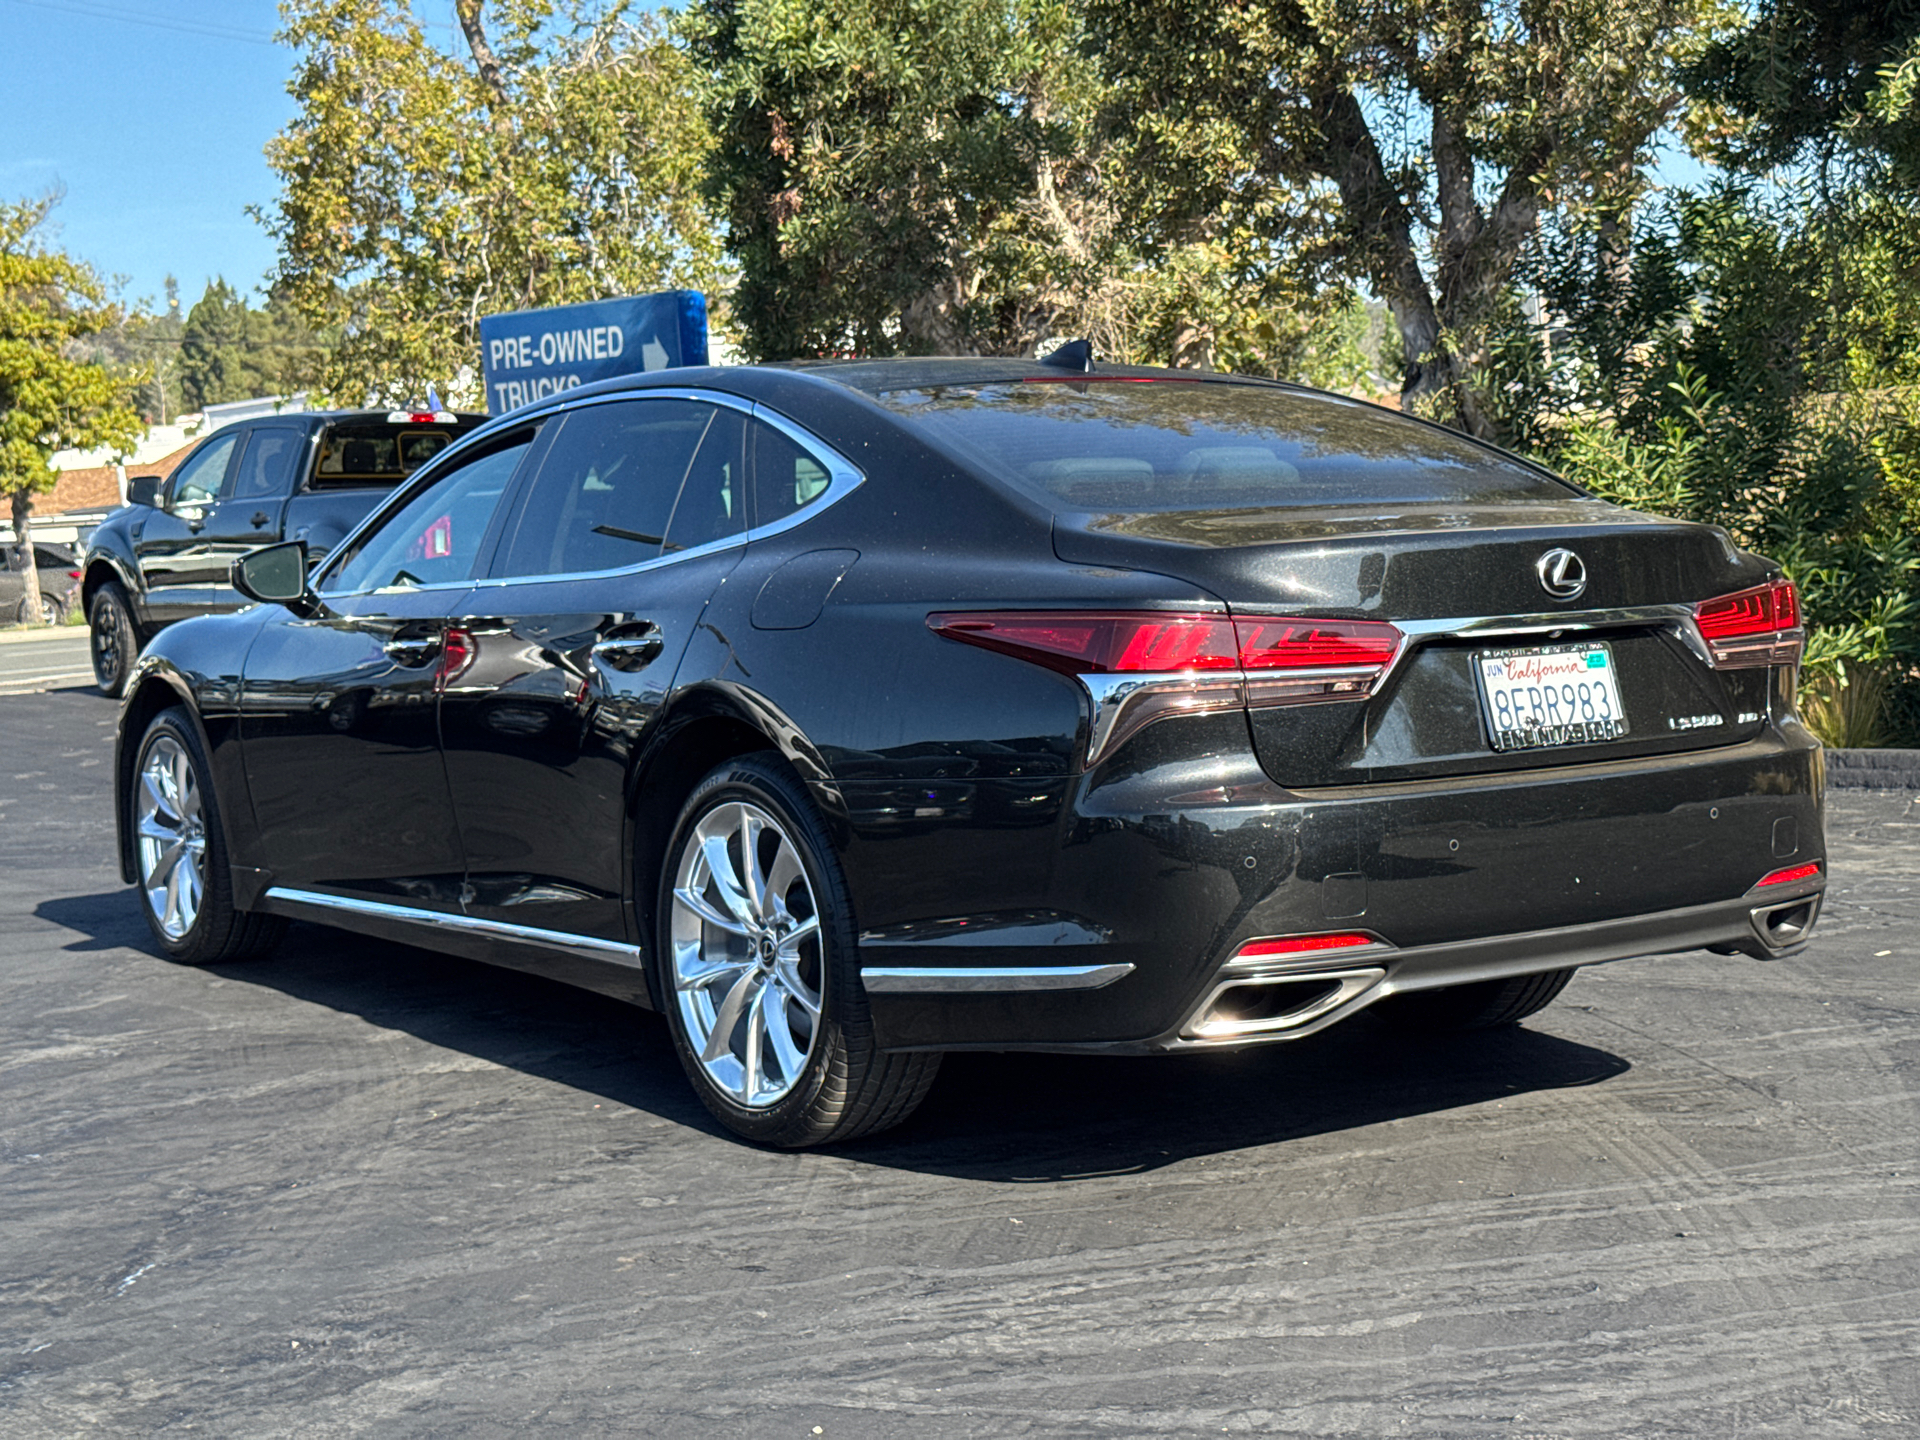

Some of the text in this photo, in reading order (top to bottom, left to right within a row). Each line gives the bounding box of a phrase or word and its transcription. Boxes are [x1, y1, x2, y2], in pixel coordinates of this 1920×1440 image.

[489, 325, 624, 371] PRE-OWNED
[1486, 664, 1504, 677] JUN
[1507, 658, 1588, 685] California
